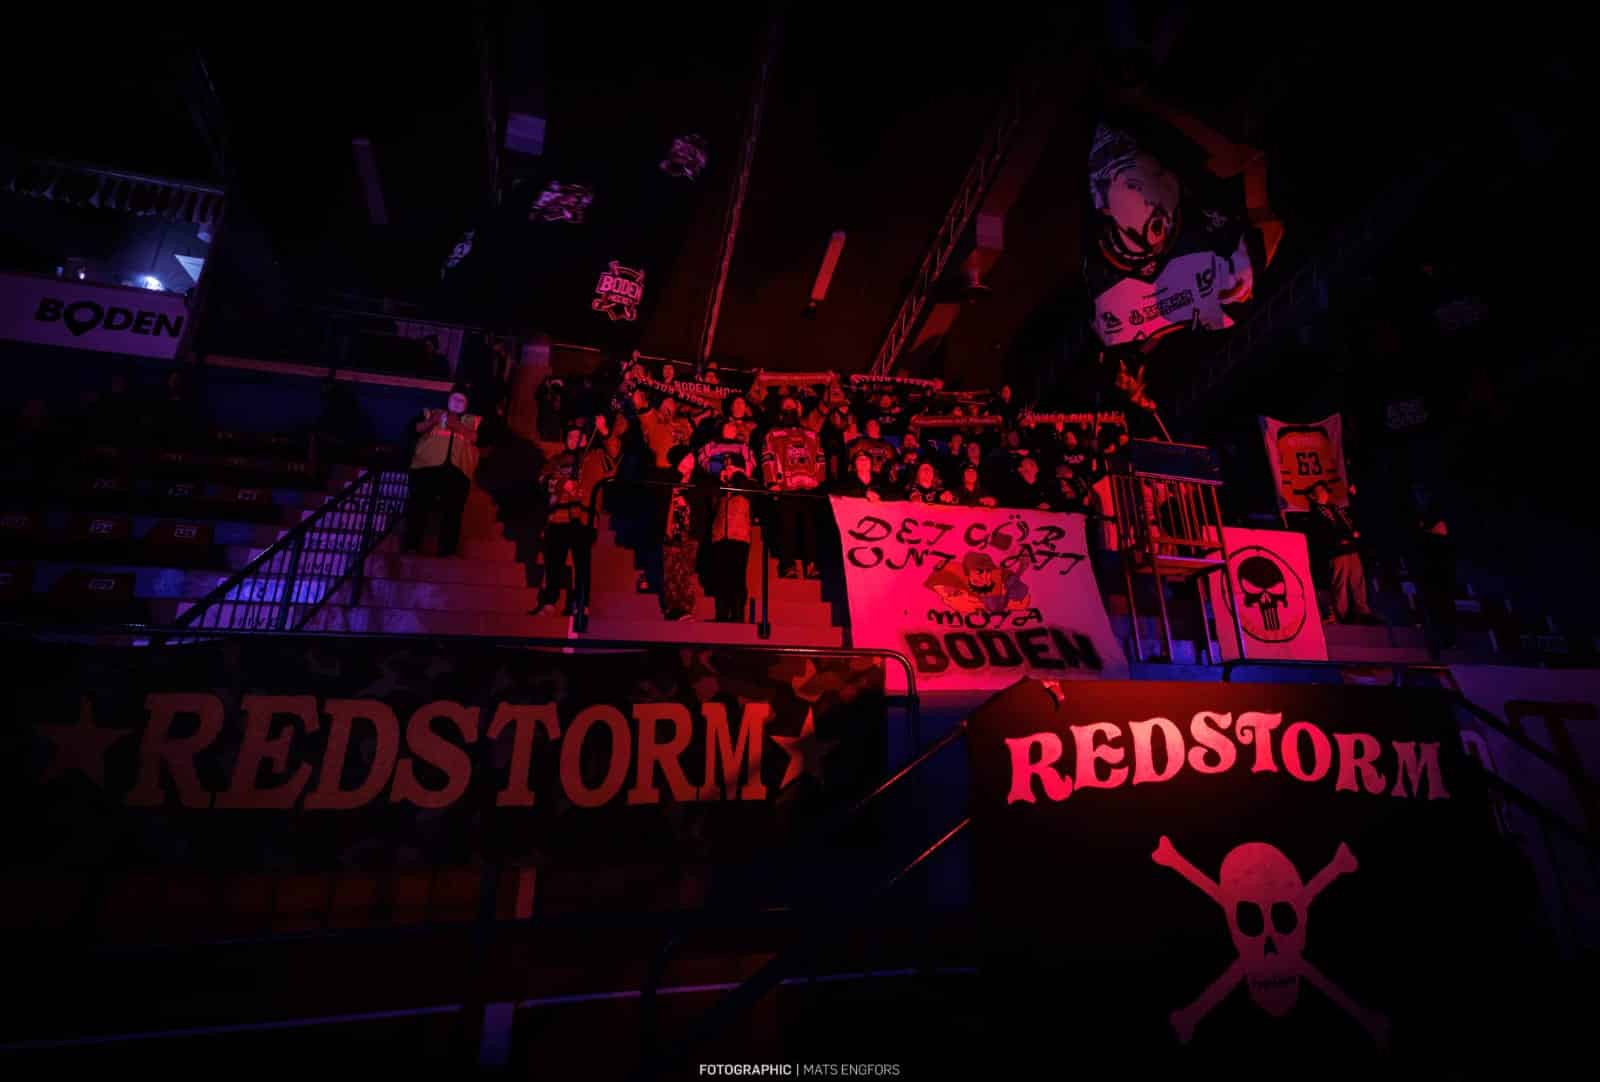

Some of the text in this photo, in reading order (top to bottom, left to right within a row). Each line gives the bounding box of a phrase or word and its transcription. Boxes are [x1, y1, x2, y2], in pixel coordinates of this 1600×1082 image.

[36, 298, 184, 338] BODEN
[1296, 452, 1322, 476] 63
[848, 516, 955, 545] DET
[848, 544, 1086, 575] ONT ATT
[905, 627, 1103, 673] BODEN
[125, 692, 770, 811] REDSTORM
[1004, 710, 1450, 805] REDSTORM
